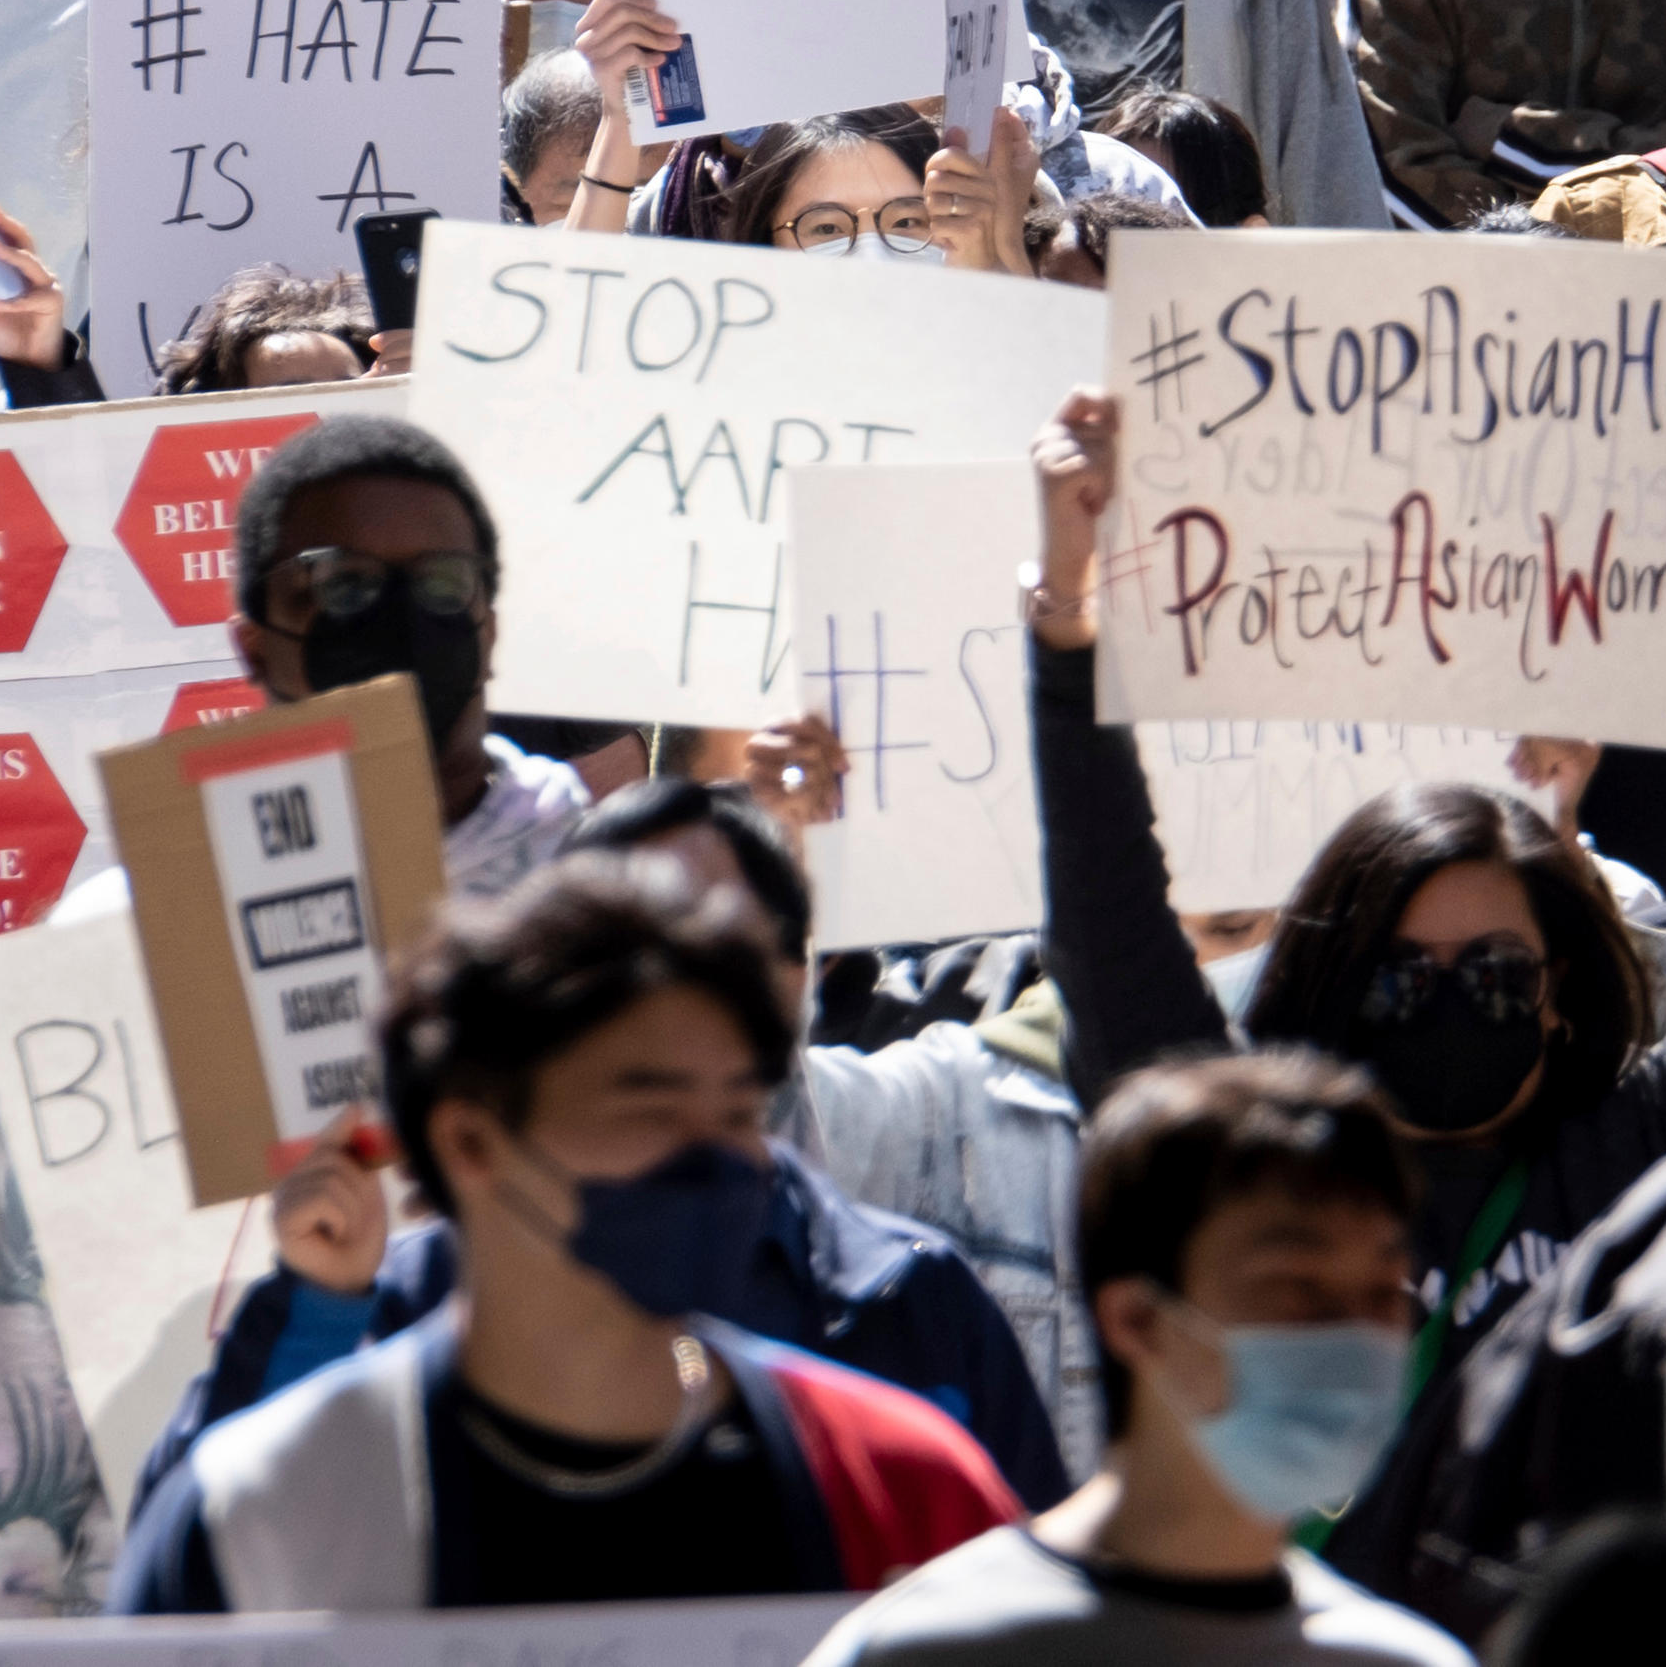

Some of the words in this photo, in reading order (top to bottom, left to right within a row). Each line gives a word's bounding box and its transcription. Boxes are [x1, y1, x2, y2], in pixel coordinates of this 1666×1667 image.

[162, 141, 253, 230] IS
[317, 141, 416, 233] A
[443, 262, 773, 384] STOP
[252, 784, 317, 859] END
